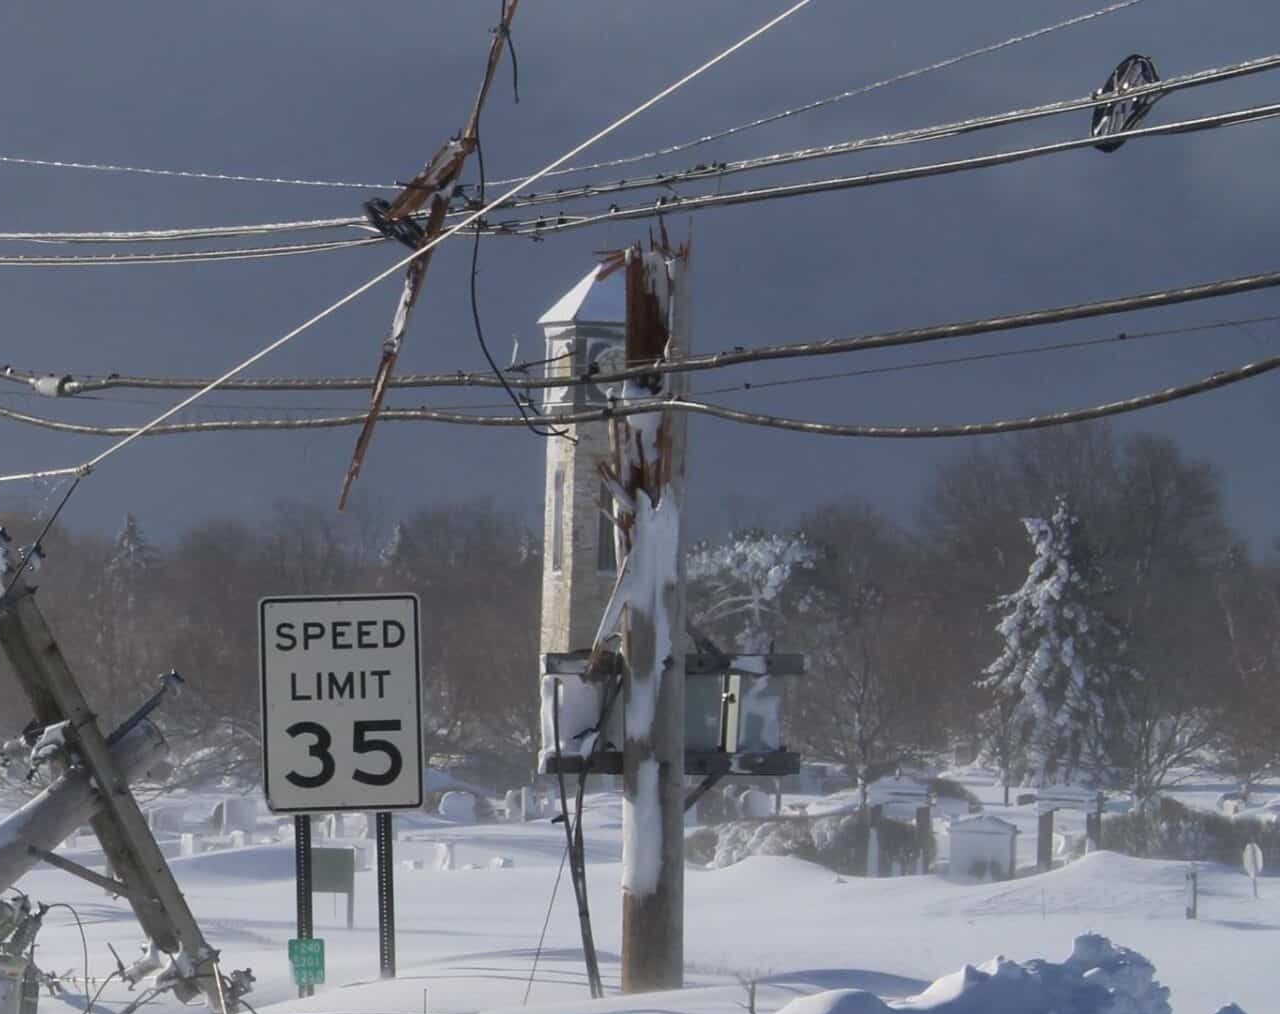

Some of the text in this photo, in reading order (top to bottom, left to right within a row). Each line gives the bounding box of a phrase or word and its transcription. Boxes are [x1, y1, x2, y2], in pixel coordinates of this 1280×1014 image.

[276, 620, 406, 651] SPEED
[291, 669, 391, 701] LIMIT
[285, 719, 403, 788] 35
